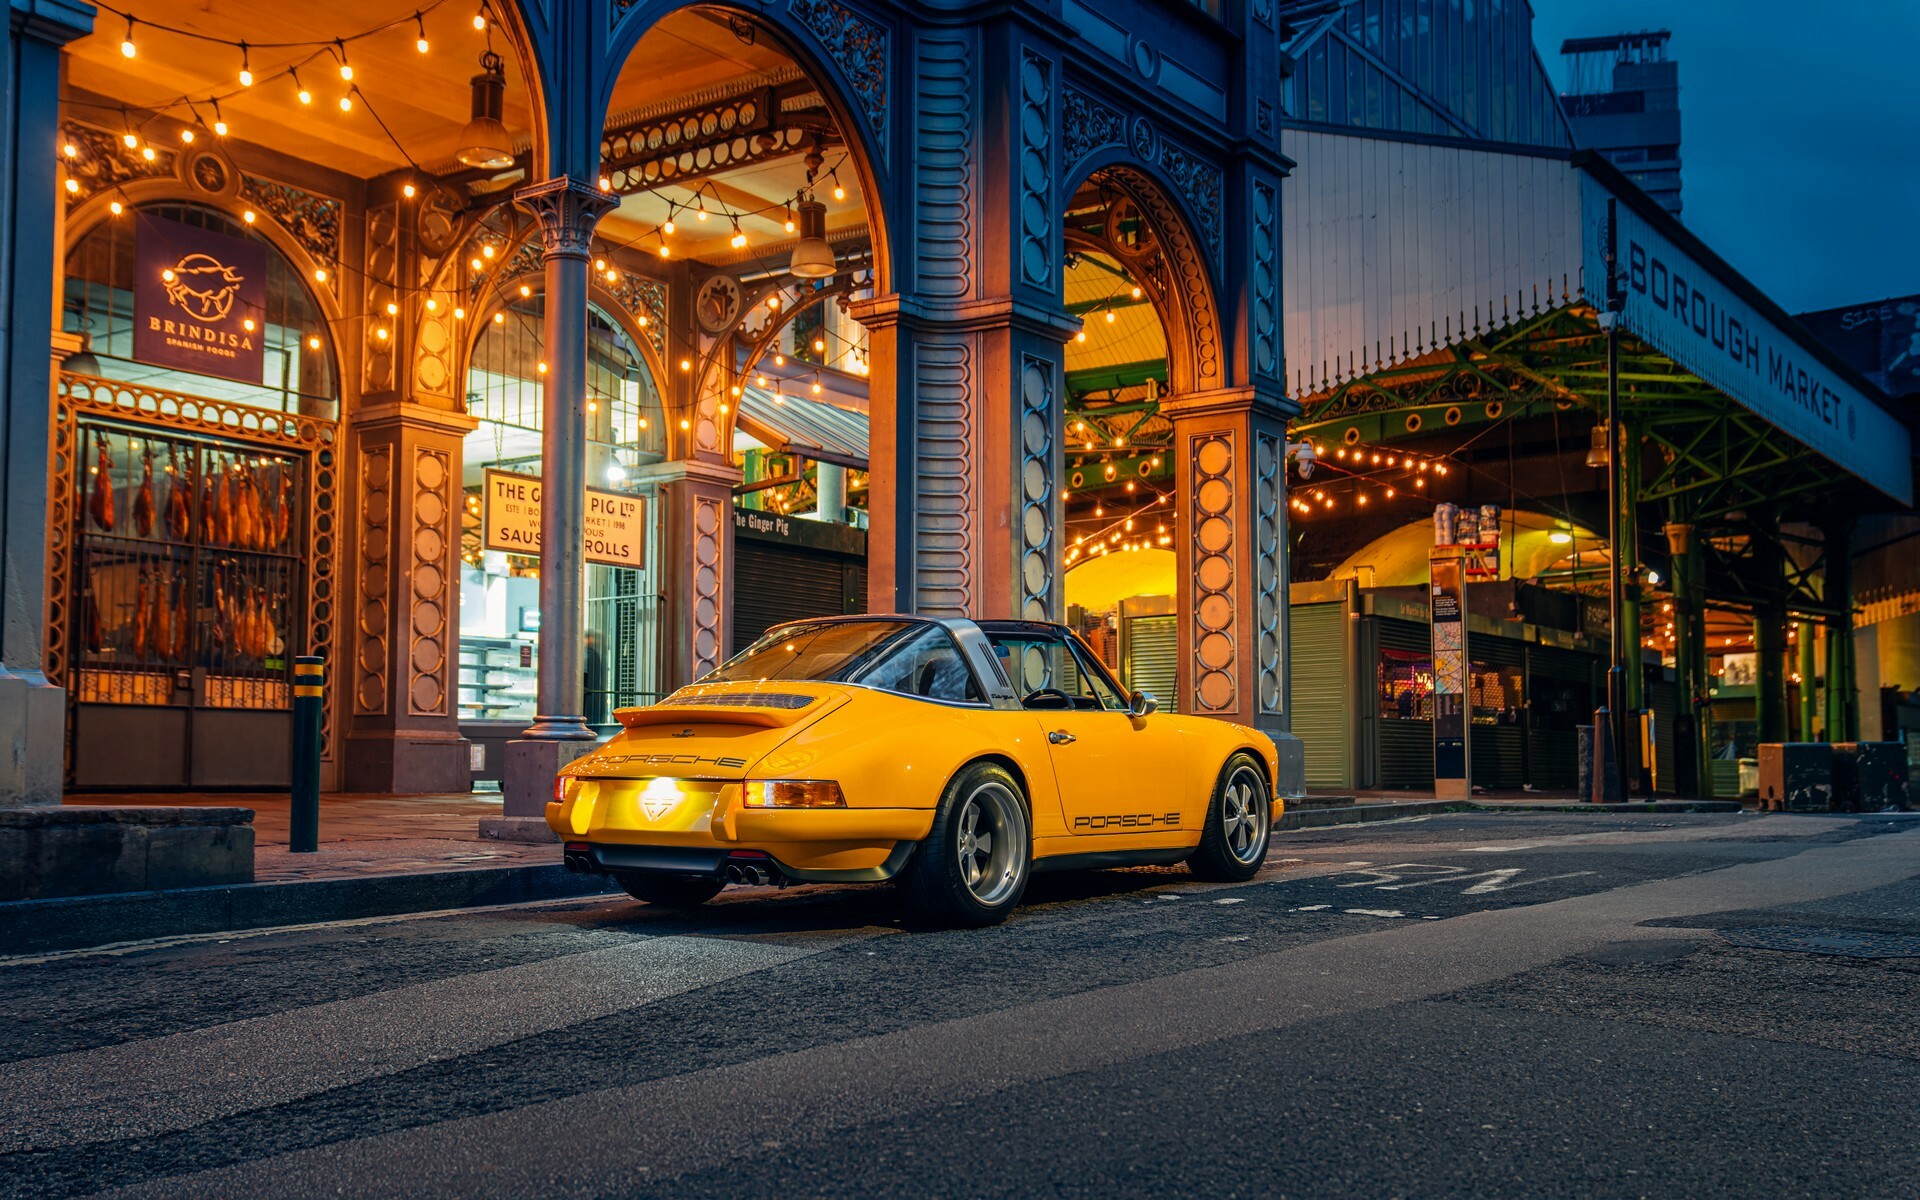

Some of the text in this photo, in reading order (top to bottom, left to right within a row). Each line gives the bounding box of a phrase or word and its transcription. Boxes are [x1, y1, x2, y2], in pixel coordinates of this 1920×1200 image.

[150, 317, 252, 350] BRINDISA
[166, 338, 204, 351] SPANISH
[1629, 239, 1842, 431] BOROUGH MARKET
[496, 481, 525, 501] THE
[591, 497, 615, 514] PIG
[585, 516, 605, 527] RKET
[748, 513, 773, 532] Ginger
[776, 517, 789, 536] Pig
[500, 527, 629, 557] SAUS ROLLS
[587, 754, 748, 769] PORSCHE
[1074, 812, 1181, 830] PORSCHE
